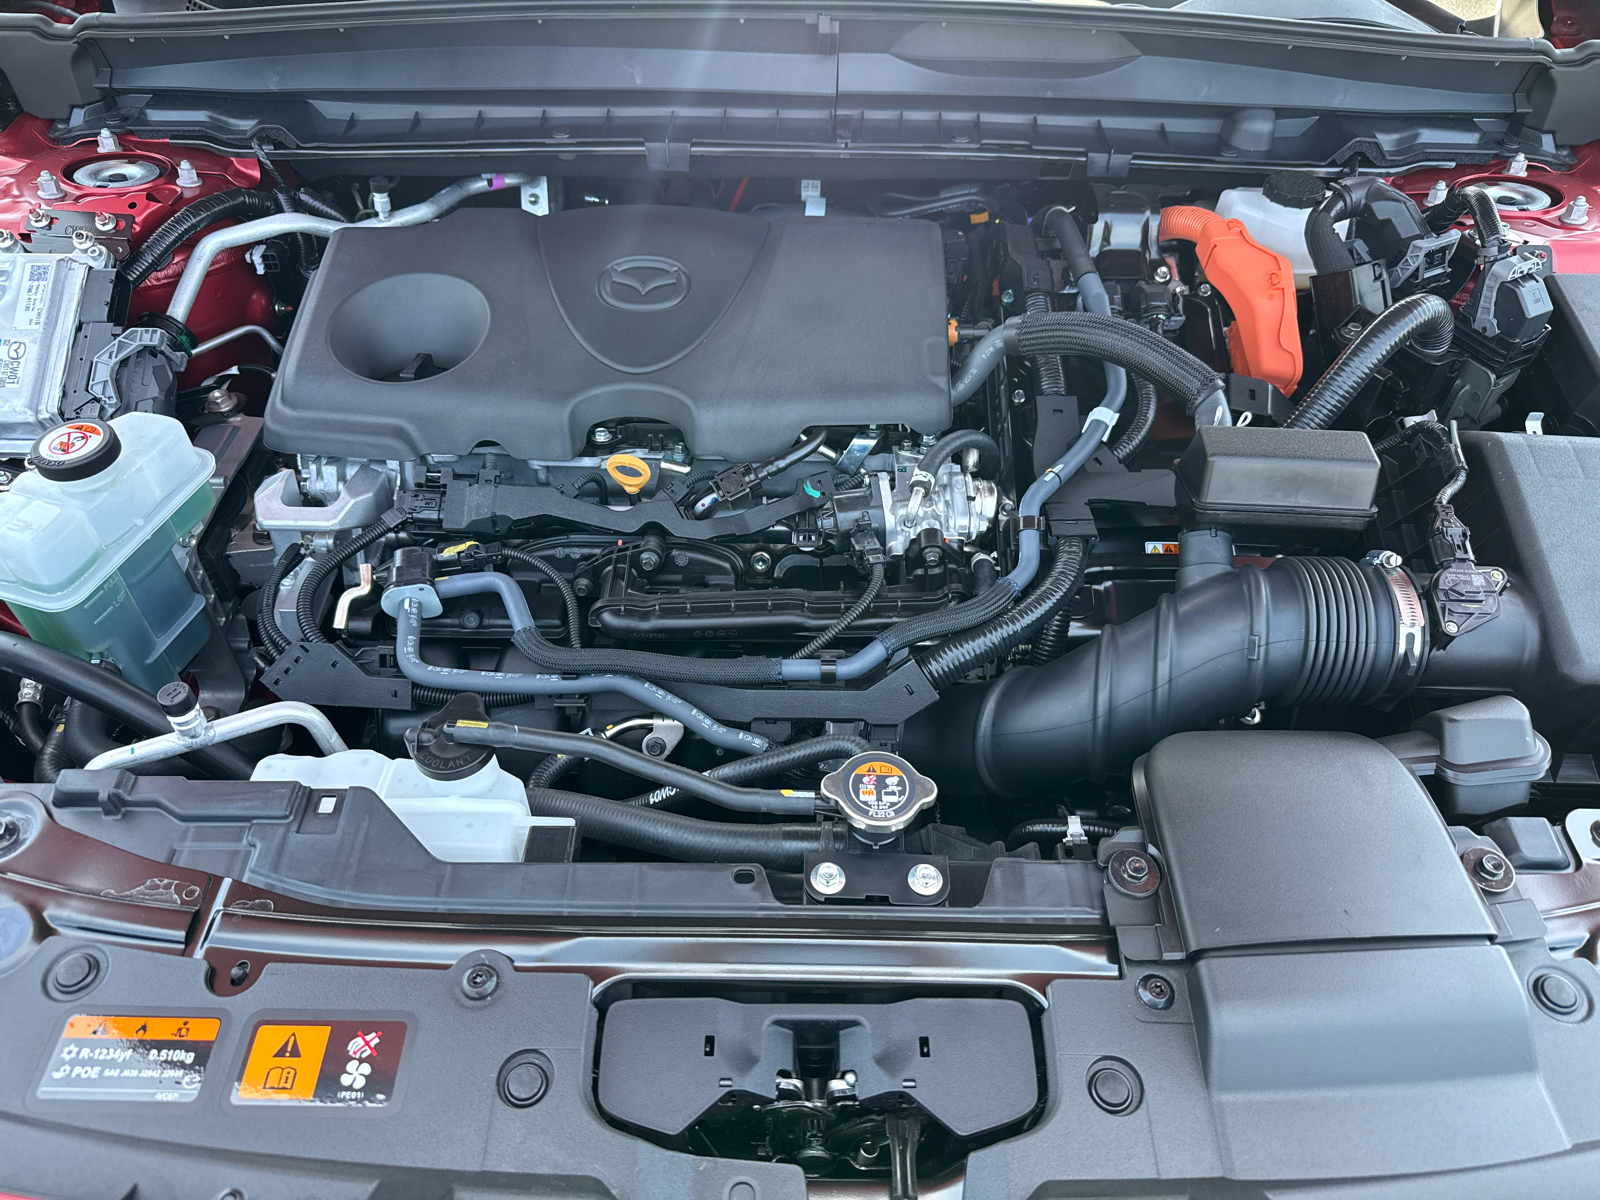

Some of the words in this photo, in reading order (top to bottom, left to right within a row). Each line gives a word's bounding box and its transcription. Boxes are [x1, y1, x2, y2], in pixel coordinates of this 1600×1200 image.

[7, 361, 20, 384] CW01
[420, 752, 471, 769] COOLANT
[71, 1066, 101, 1078] POE
